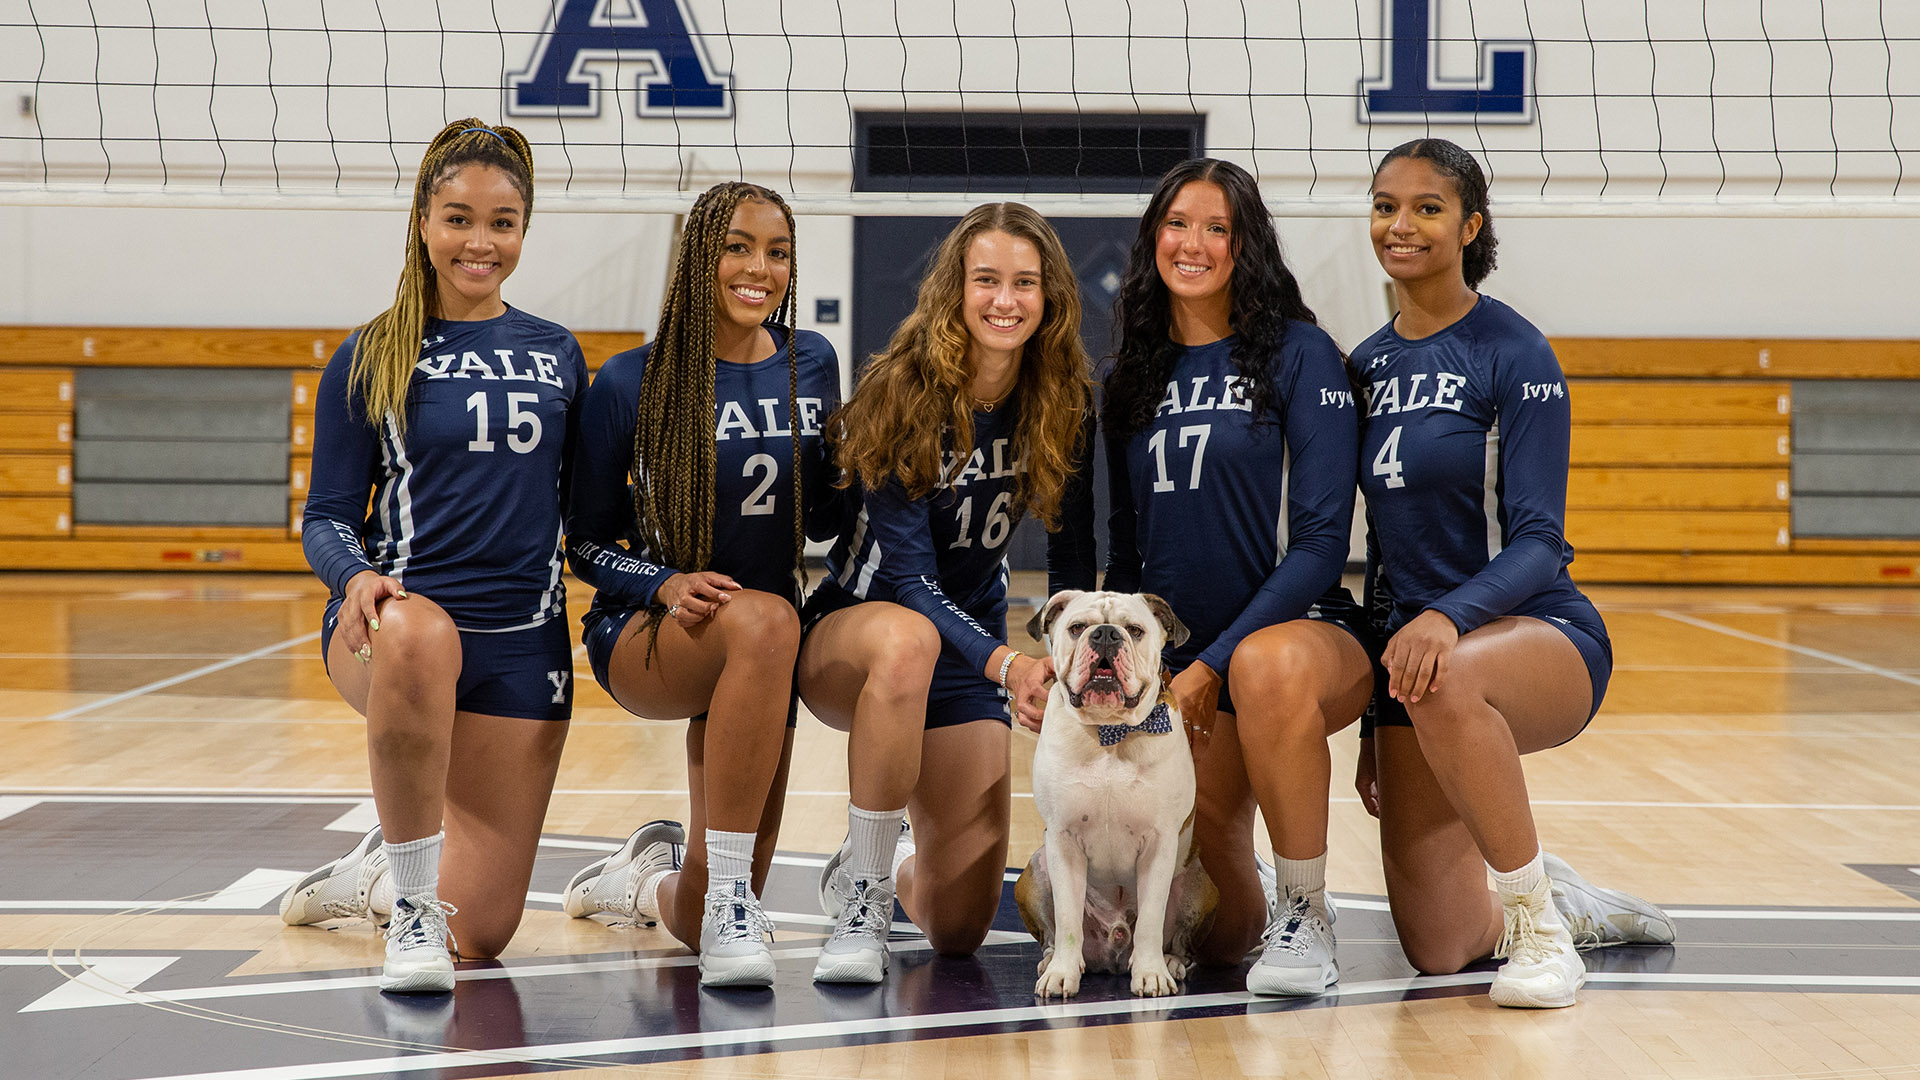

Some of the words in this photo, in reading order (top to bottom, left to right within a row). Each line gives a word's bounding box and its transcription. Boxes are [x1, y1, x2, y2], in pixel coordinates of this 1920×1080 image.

[505, 0, 734, 117] A
[1356, 0, 1534, 124] L
[415, 349, 563, 390] YALE
[1522, 381, 1555, 402] Ivy
[1154, 375, 1255, 418] ALE
[1320, 388, 1347, 408] Ivy
[1362, 372, 1467, 418] YALE
[466, 391, 542, 454] 15
[714, 397, 822, 441] ALE
[933, 438, 1030, 490] YAL
[1148, 424, 1211, 493] 17
[1372, 425, 1406, 489] 4
[741, 453, 778, 516] 2
[949, 491, 1012, 550] 16
[572, 541, 600, 560] UX
[593, 550, 617, 567] ET
[547, 670, 569, 704] Y
